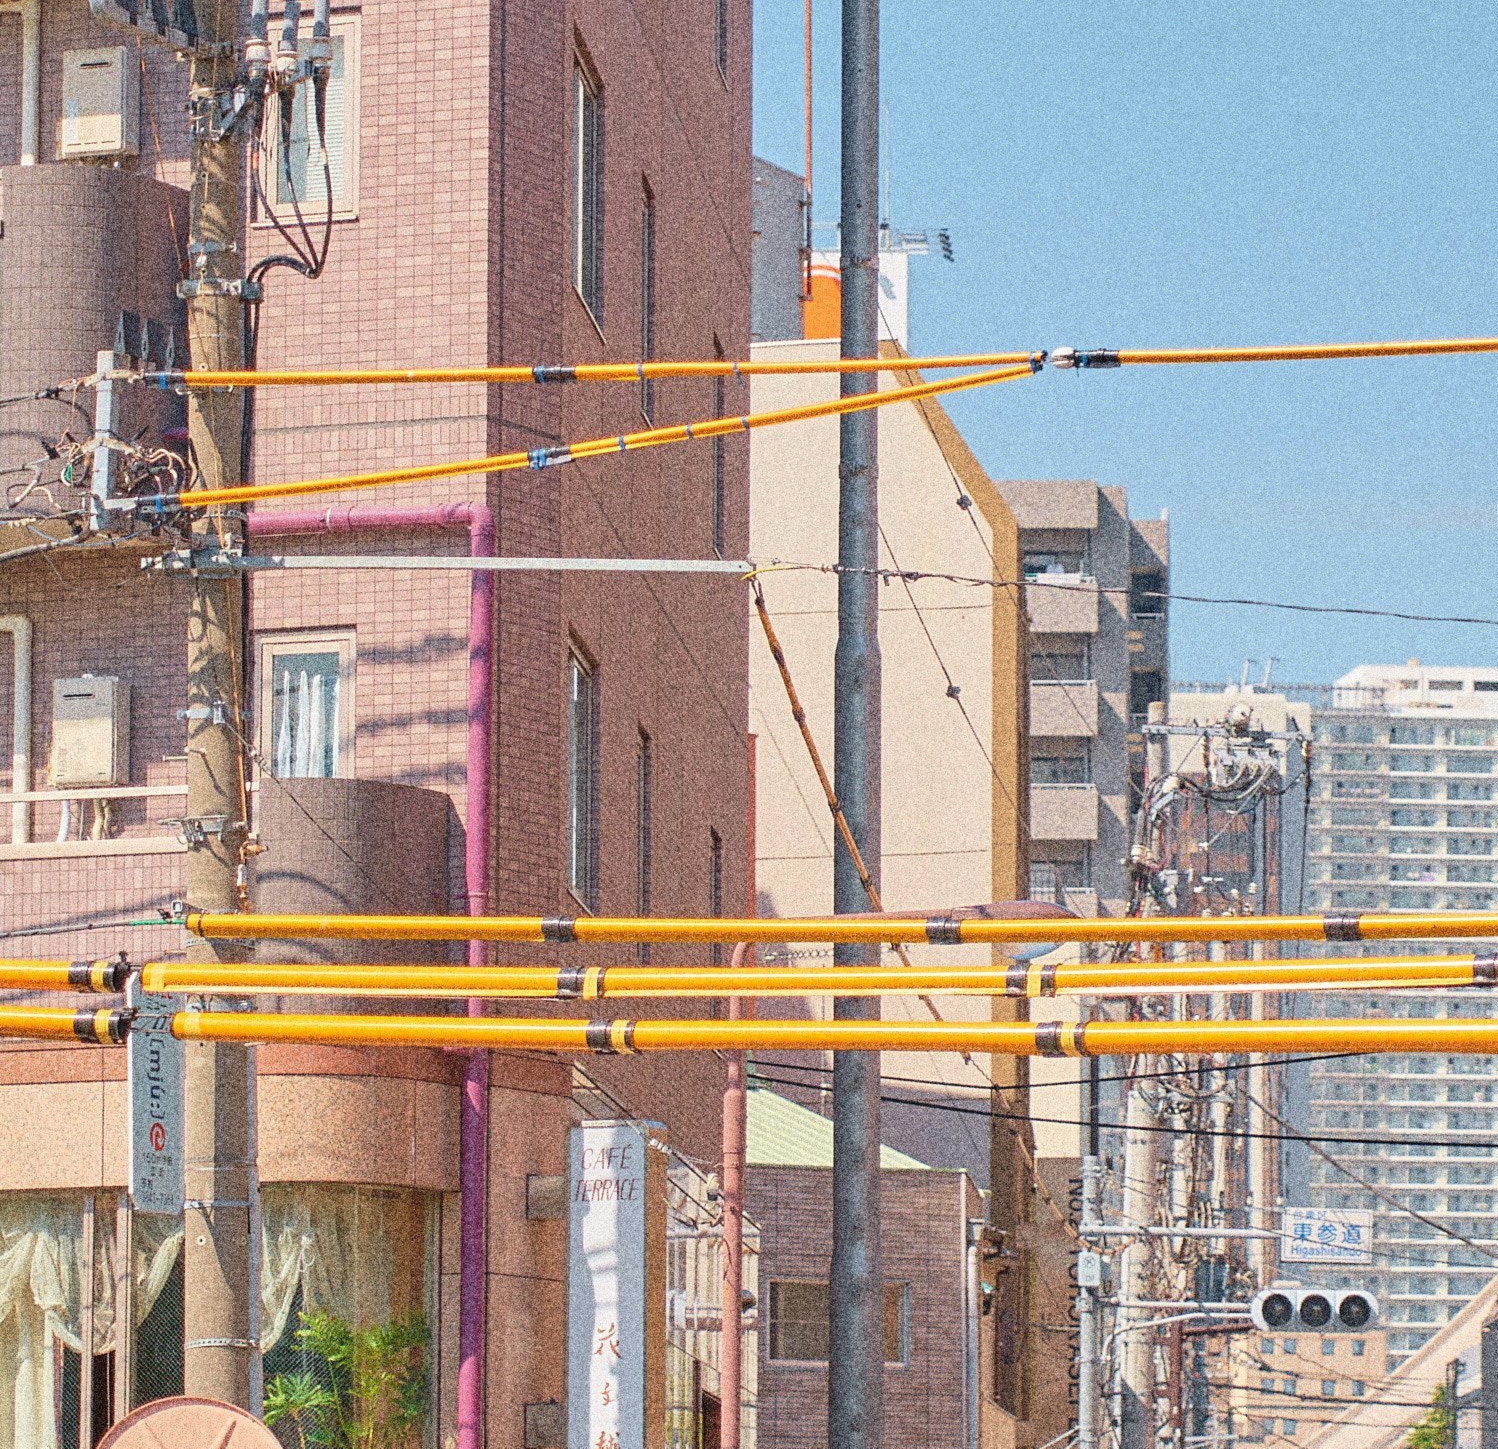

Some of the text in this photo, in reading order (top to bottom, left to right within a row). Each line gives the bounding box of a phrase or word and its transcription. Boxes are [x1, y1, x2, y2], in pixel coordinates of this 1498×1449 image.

[581, 1143, 632, 1170] CAFÉ
[574, 1177, 640, 1203] TERRACE
[1292, 1223, 1361, 1245] 東参道
